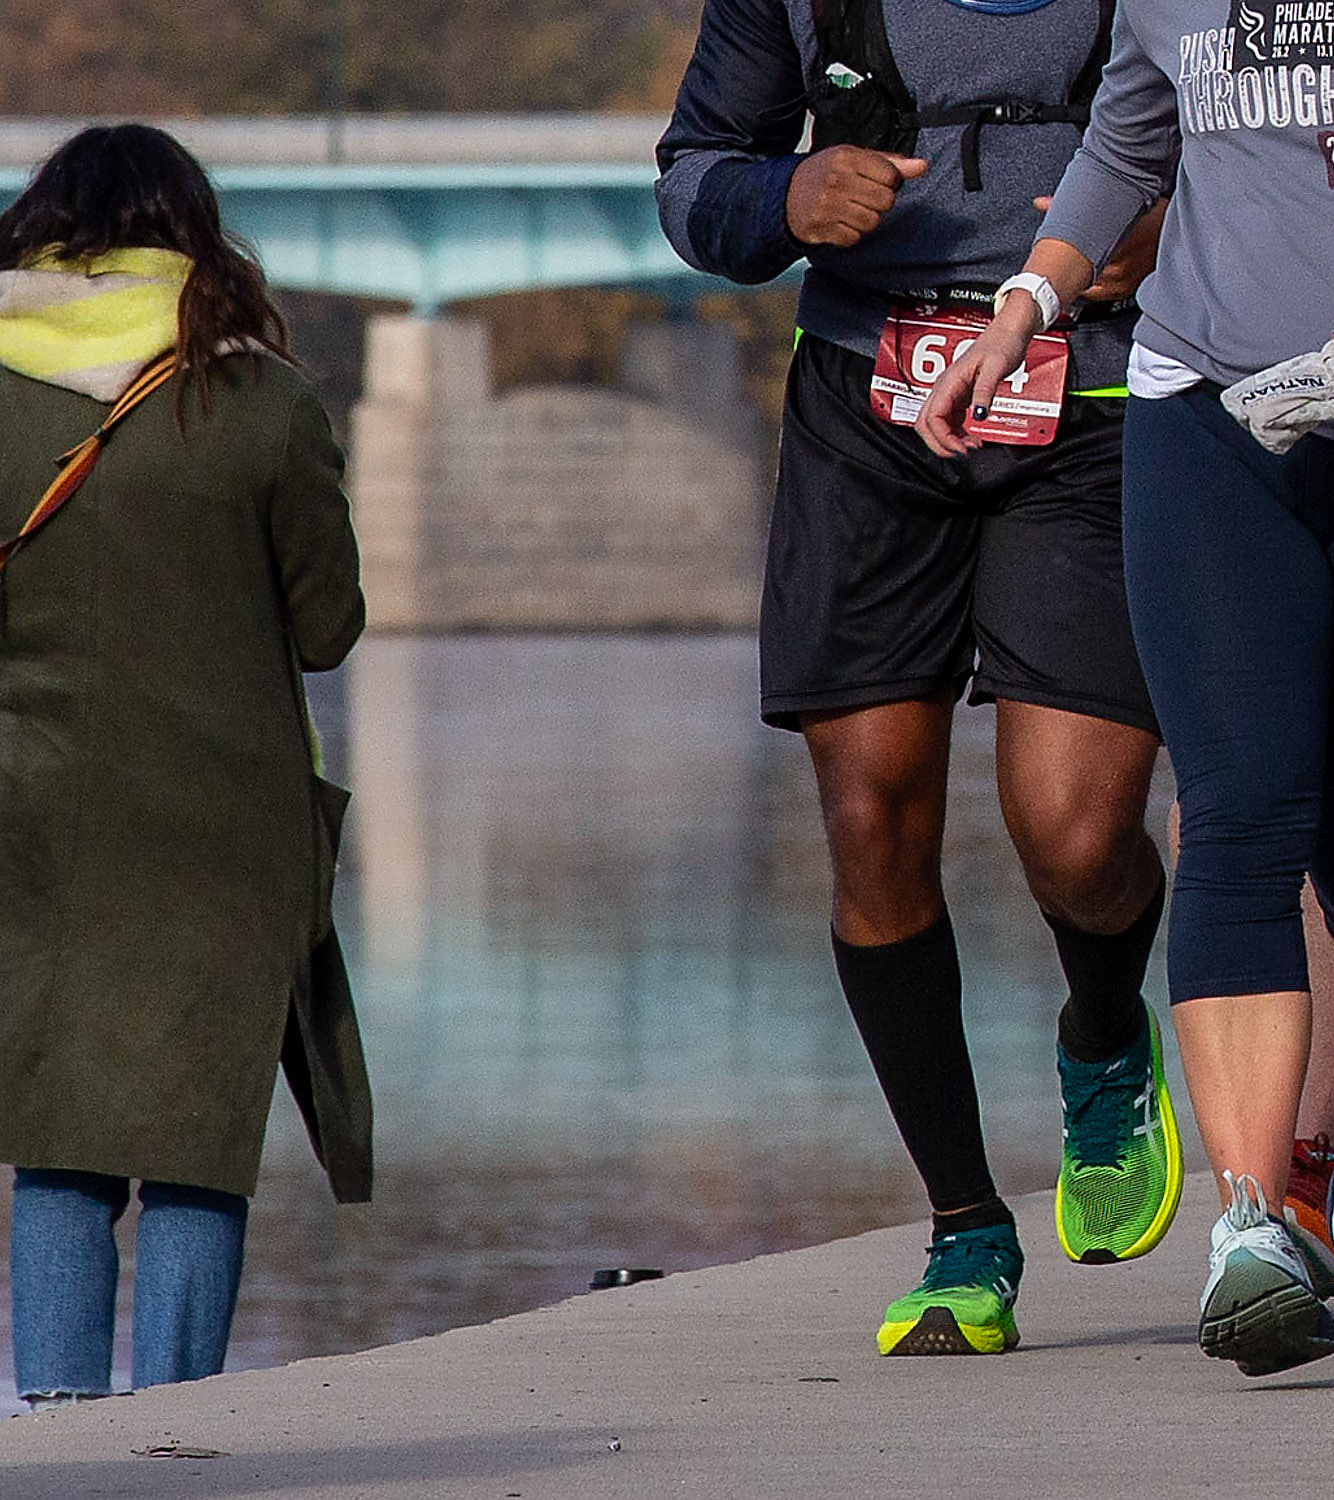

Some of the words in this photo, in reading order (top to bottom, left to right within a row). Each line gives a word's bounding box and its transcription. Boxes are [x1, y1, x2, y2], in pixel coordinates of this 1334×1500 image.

[1180, 27, 1236, 79] PUSH
[1316, 46, 1333, 57] 13.1
[911, 334, 1029, 394] 64
[1242, 378, 1325, 405] NATHAN
